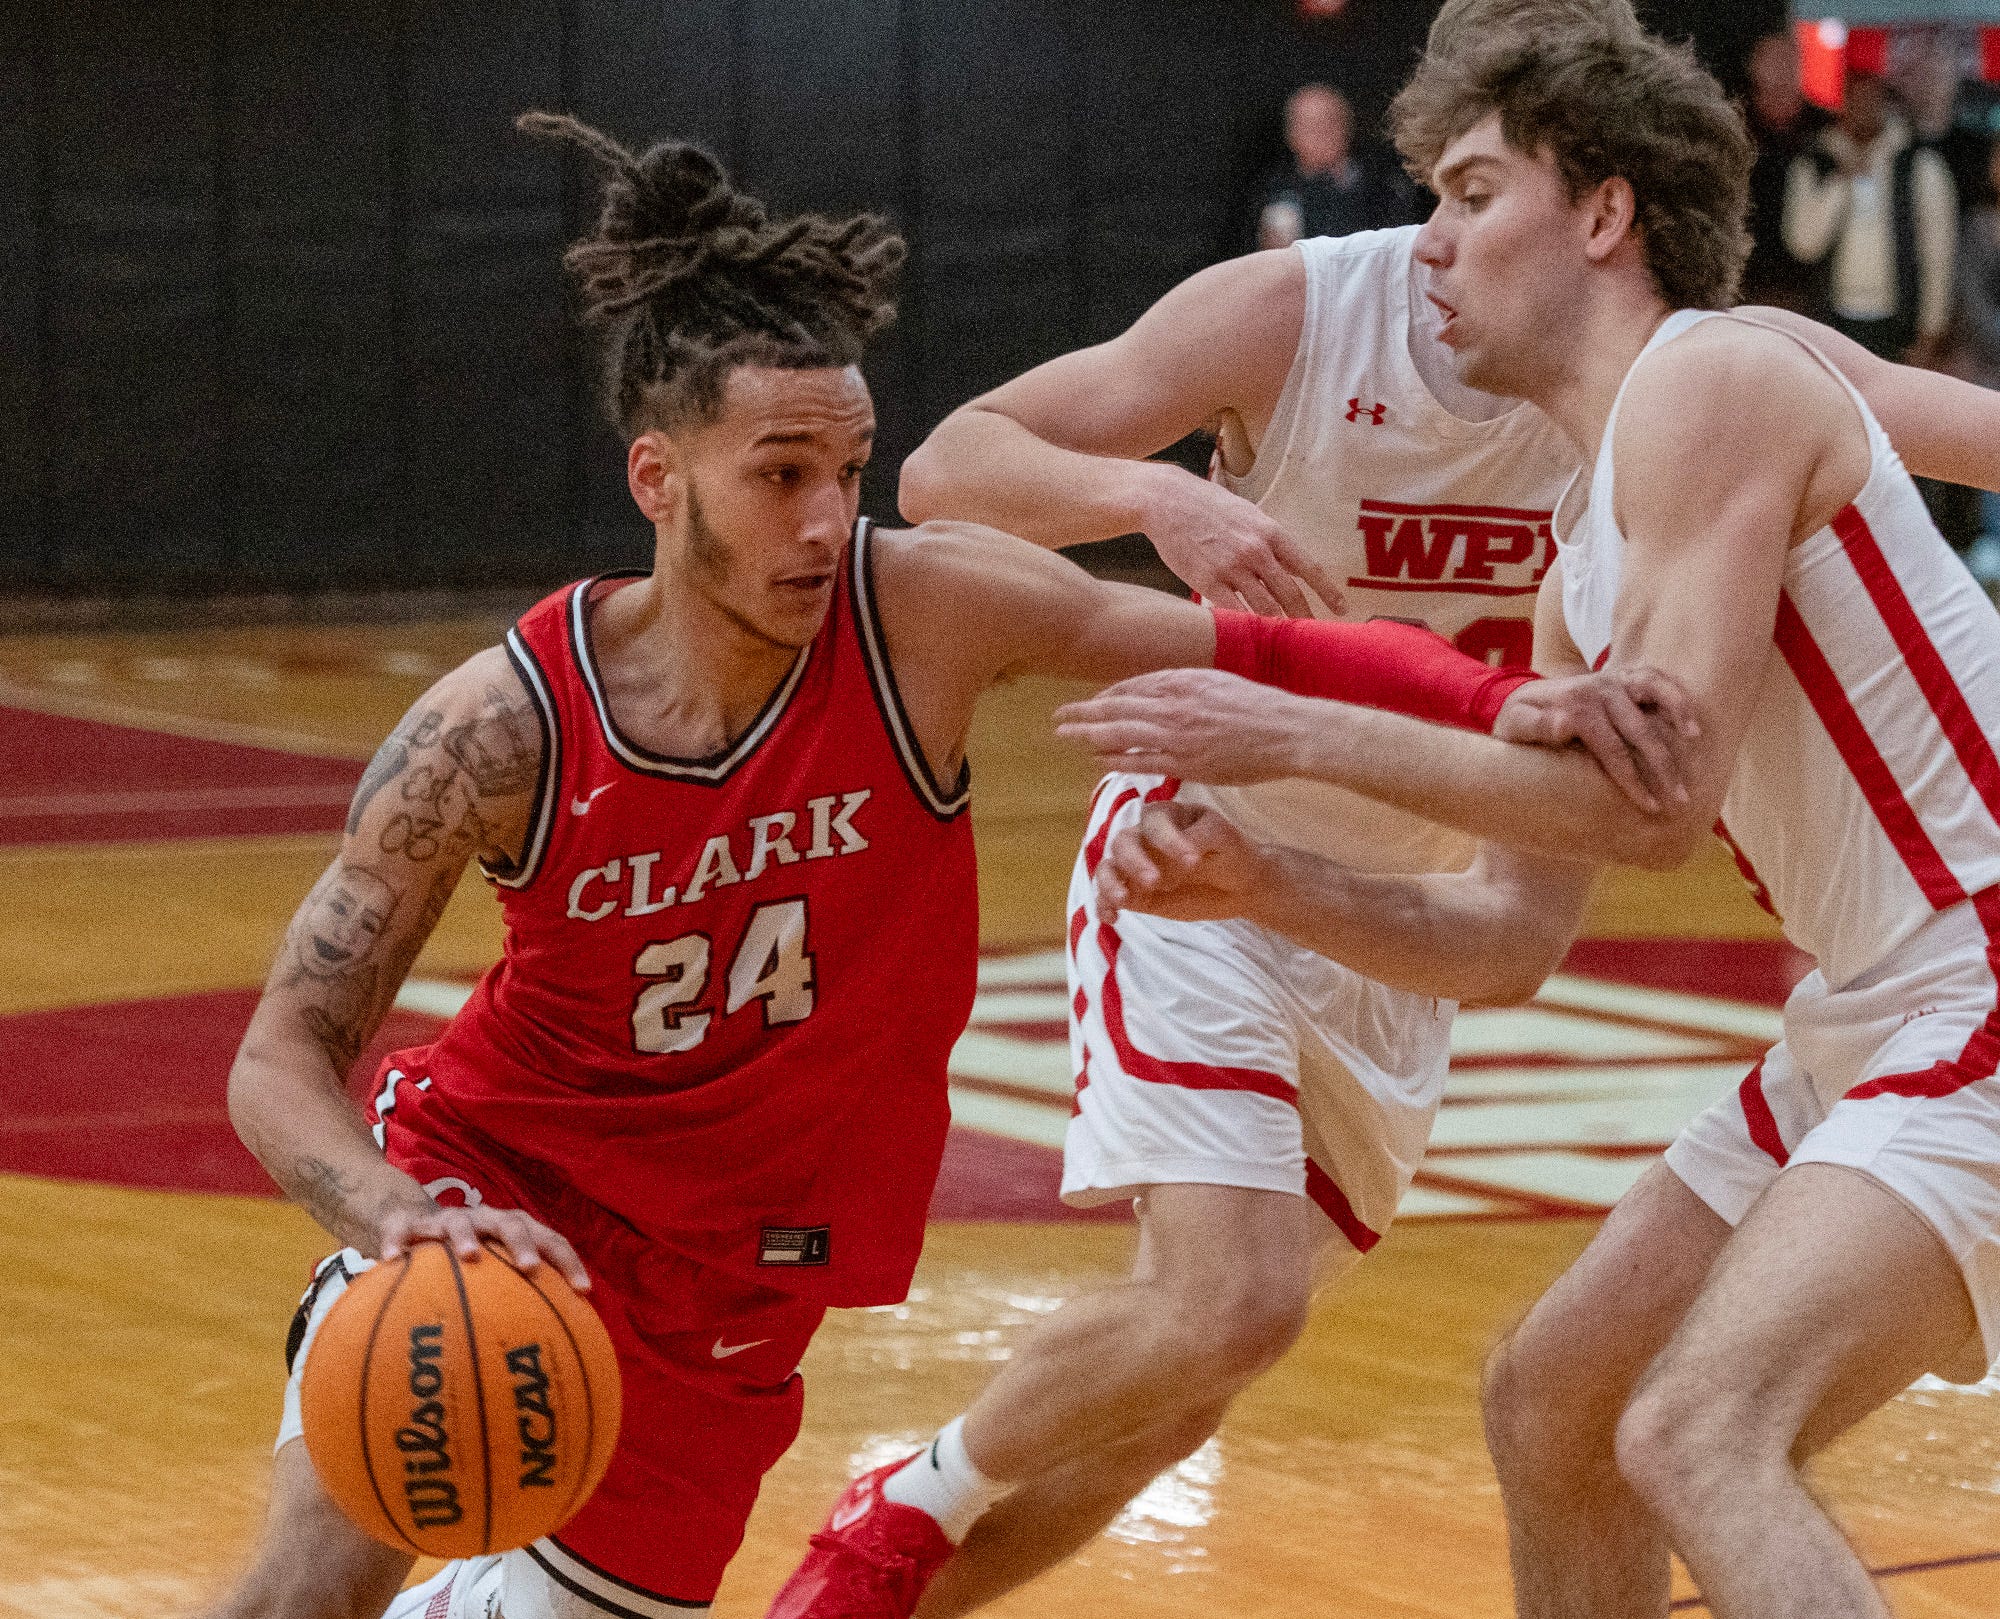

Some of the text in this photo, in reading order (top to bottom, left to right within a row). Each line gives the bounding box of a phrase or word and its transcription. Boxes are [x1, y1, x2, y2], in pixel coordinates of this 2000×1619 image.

[566, 788, 872, 922] CLARK
[631, 893, 818, 1053] 24
[395, 1324, 463, 1530] Wilson
[506, 1343, 557, 1489] NCAA
